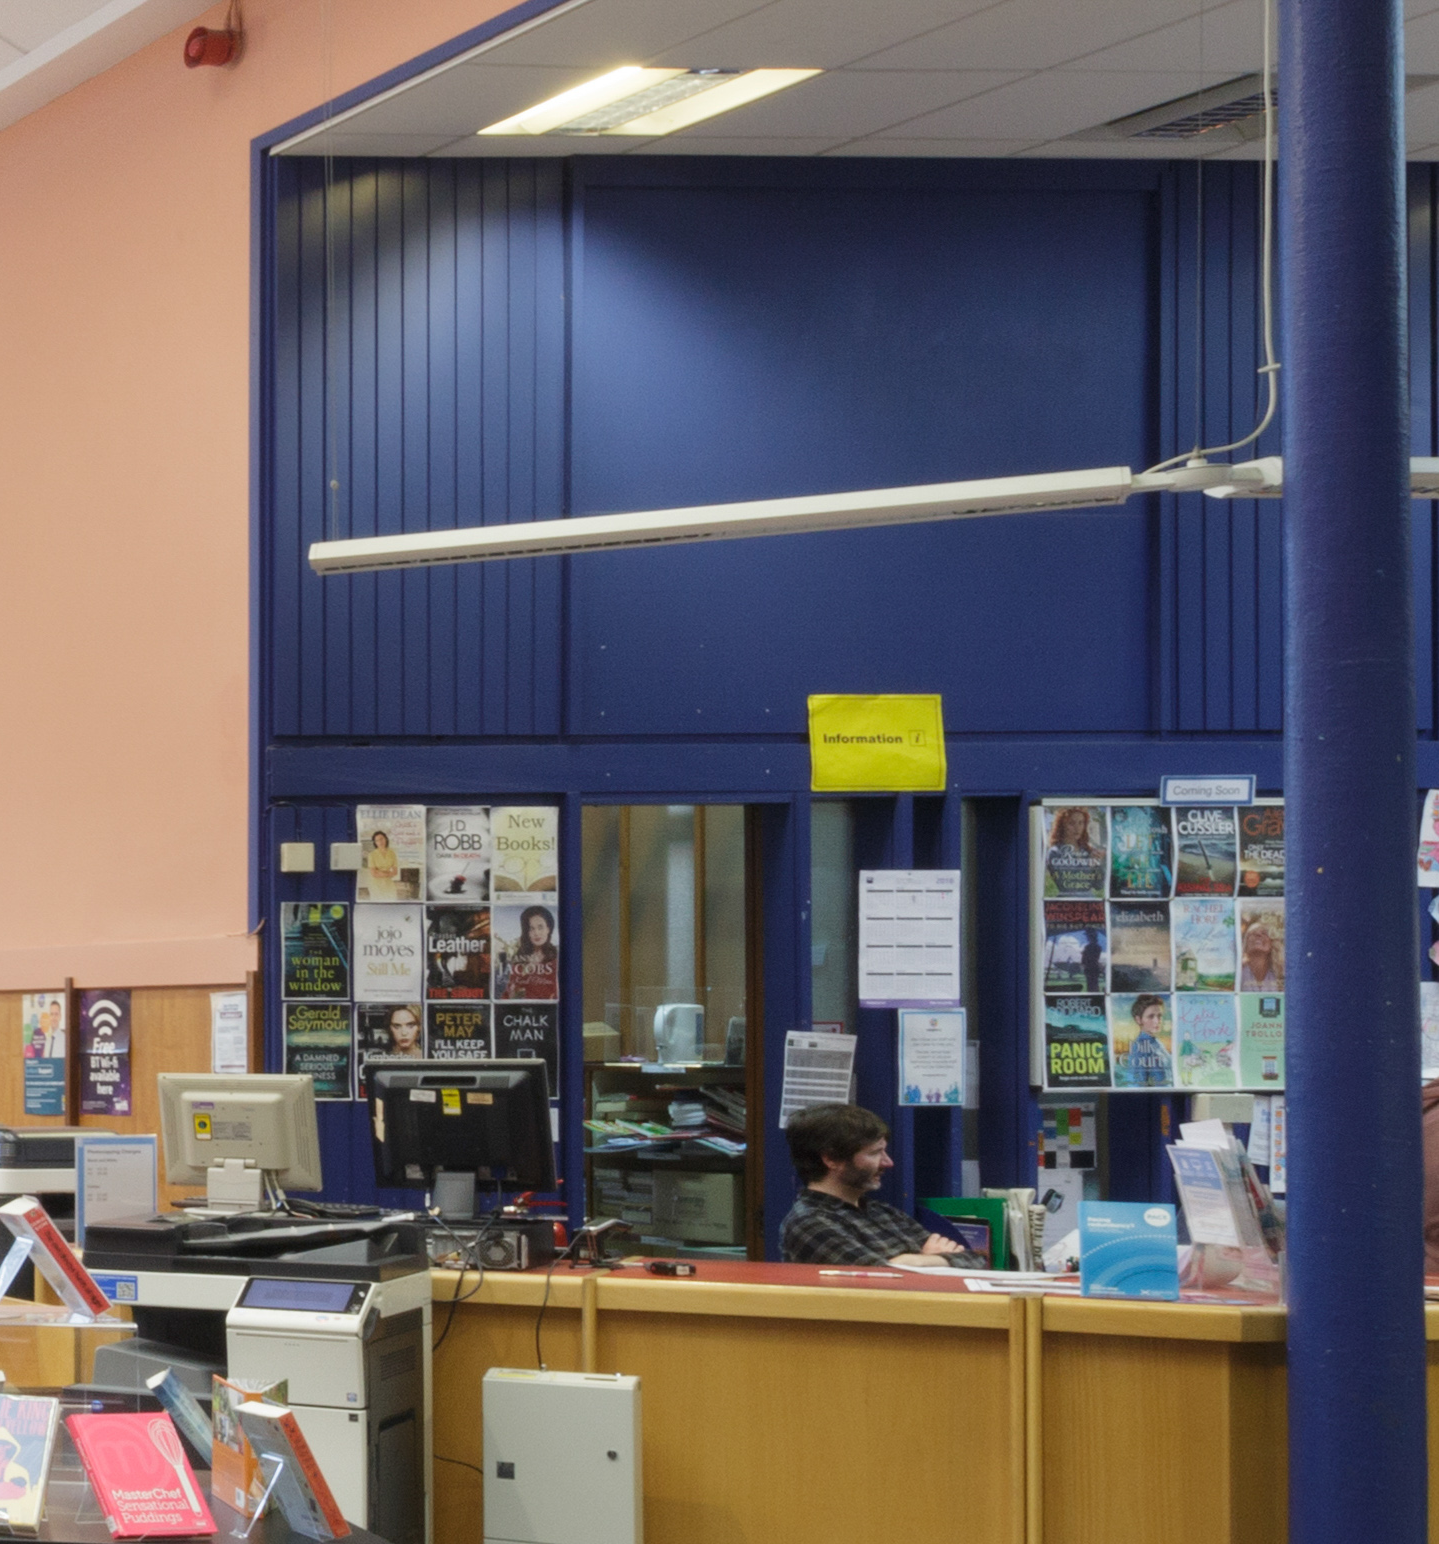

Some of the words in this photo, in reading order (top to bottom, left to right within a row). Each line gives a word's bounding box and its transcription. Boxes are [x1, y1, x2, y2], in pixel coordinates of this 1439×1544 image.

[822, 732, 903, 745] Information
[1172, 786, 1213, 798] Coming
[1214, 786, 1241, 797] Soon
[360, 809, 389, 819] ELLIE
[392, 809, 422, 819] DEAN
[506, 813, 546, 829] New
[1187, 809, 1224, 824] CLIVE
[1177, 821, 1235, 836] CUSSLER
[433, 833, 484, 851] ROBB
[495, 836, 555, 852] Books!
[1115, 909, 1165, 924] elizabeth
[373, 925, 403, 946] jojo
[362, 942, 415, 960] moyes
[428, 935, 487, 954] Leather
[290, 955, 340, 967] woman
[295, 967, 308, 979] in
[311, 966, 335, 979] the
[496, 963, 553, 977] JACOBS
[288, 979, 342, 991] window
[295, 1005, 341, 1019] Gerald
[435, 1012, 482, 1026] PETER
[287, 1016, 349, 1031] Seymour
[503, 1014, 549, 1028] CHALK
[443, 1025, 473, 1038] MAY
[509, 1029, 544, 1042] MAN
[92, 1037, 116, 1059] Free
[1049, 1041, 1104, 1060] PANIC
[90, 1056, 101, 1071] BT
[101, 1056, 119, 1071] Wi-fi
[1050, 1058, 1106, 1075] ROOM
[89, 1070, 122, 1084] available
[96, 1082, 114, 1097] here
[17, 1397, 52, 1422] KING
[110, 1487, 182, 1503] MasterChef
[116, 1499, 190, 1514] Sensational
[122, 1511, 184, 1526] Puddings
